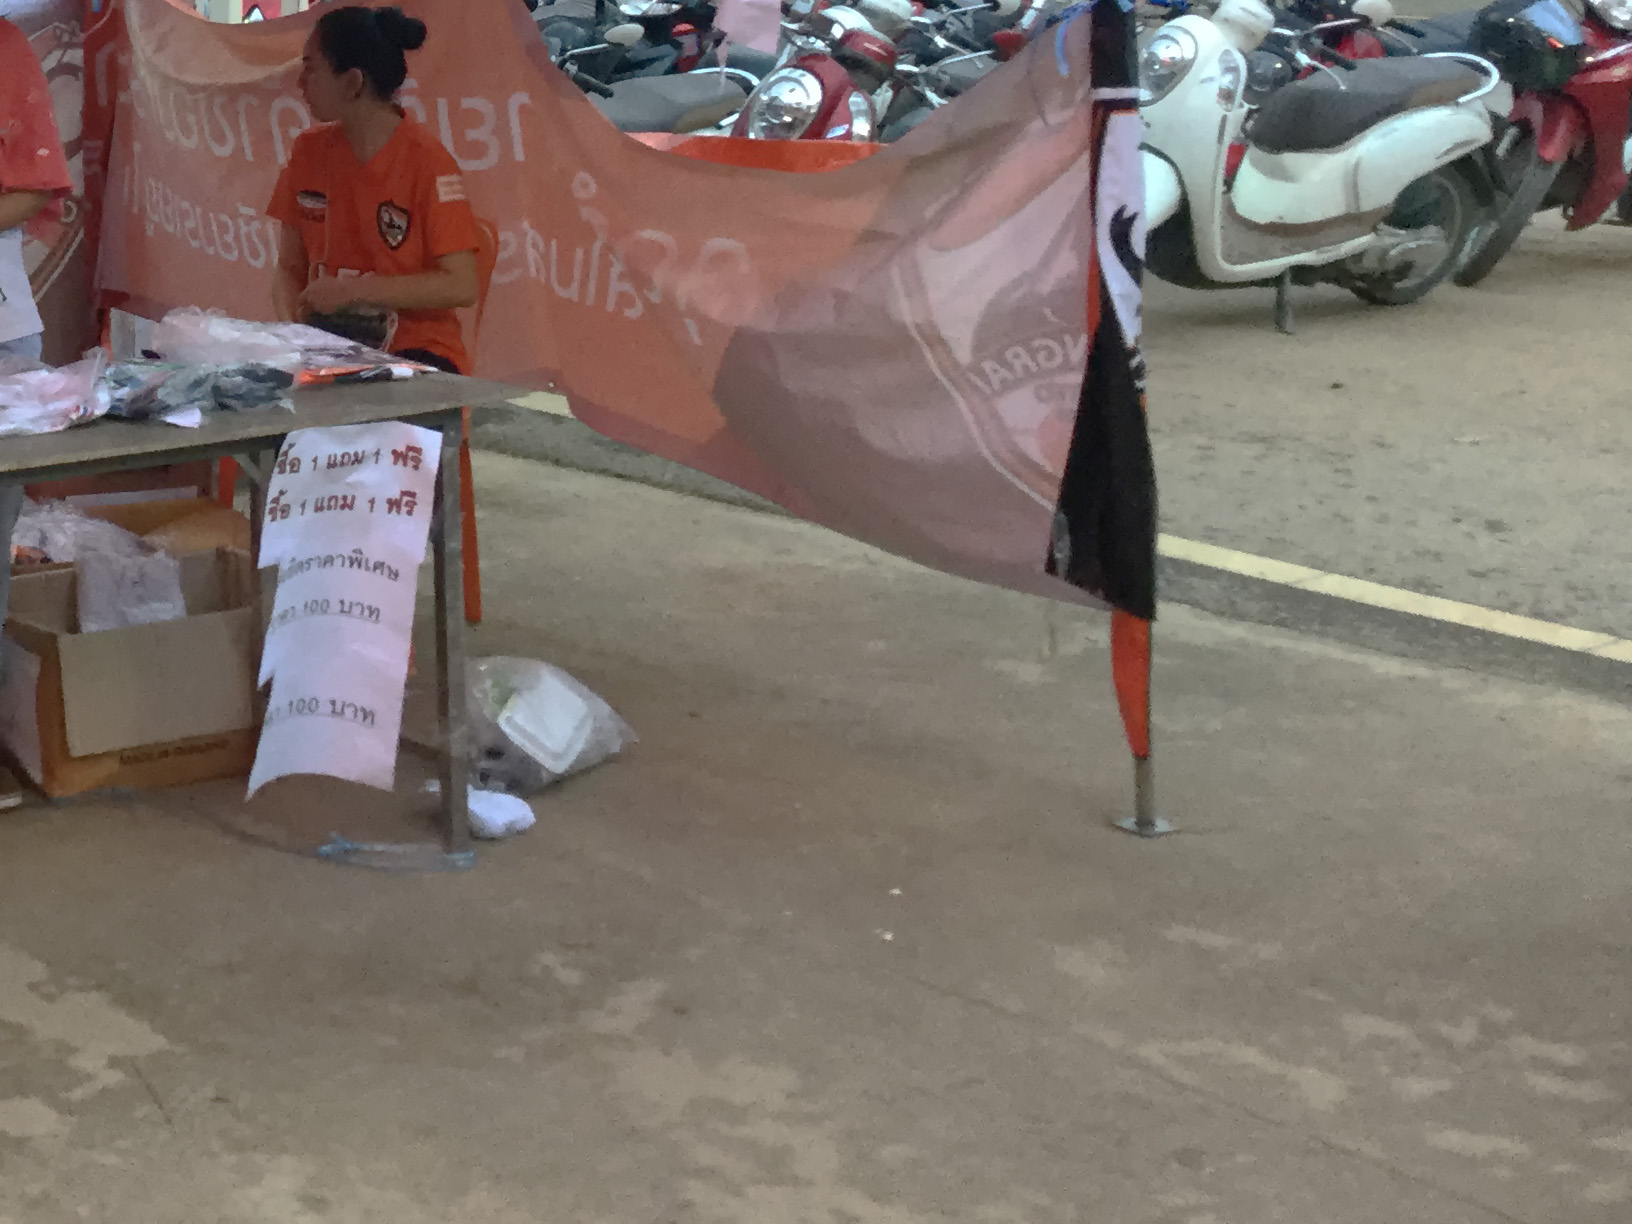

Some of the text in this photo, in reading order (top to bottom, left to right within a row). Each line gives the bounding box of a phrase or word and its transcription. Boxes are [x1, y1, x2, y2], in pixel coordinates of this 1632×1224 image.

[311, 455, 319, 471] 1
[325, 450, 366, 470] แถม
[372, 448, 382, 465] 1
[391, 443, 424, 471] ฟรี
[267, 489, 418, 523] ซื้อ 1 แถม 1 ฟรี
[302, 598, 330, 615] 100
[338, 598, 381, 624] บาท
[288, 697, 320, 716] 100
[329, 698, 375, 726] บาท
